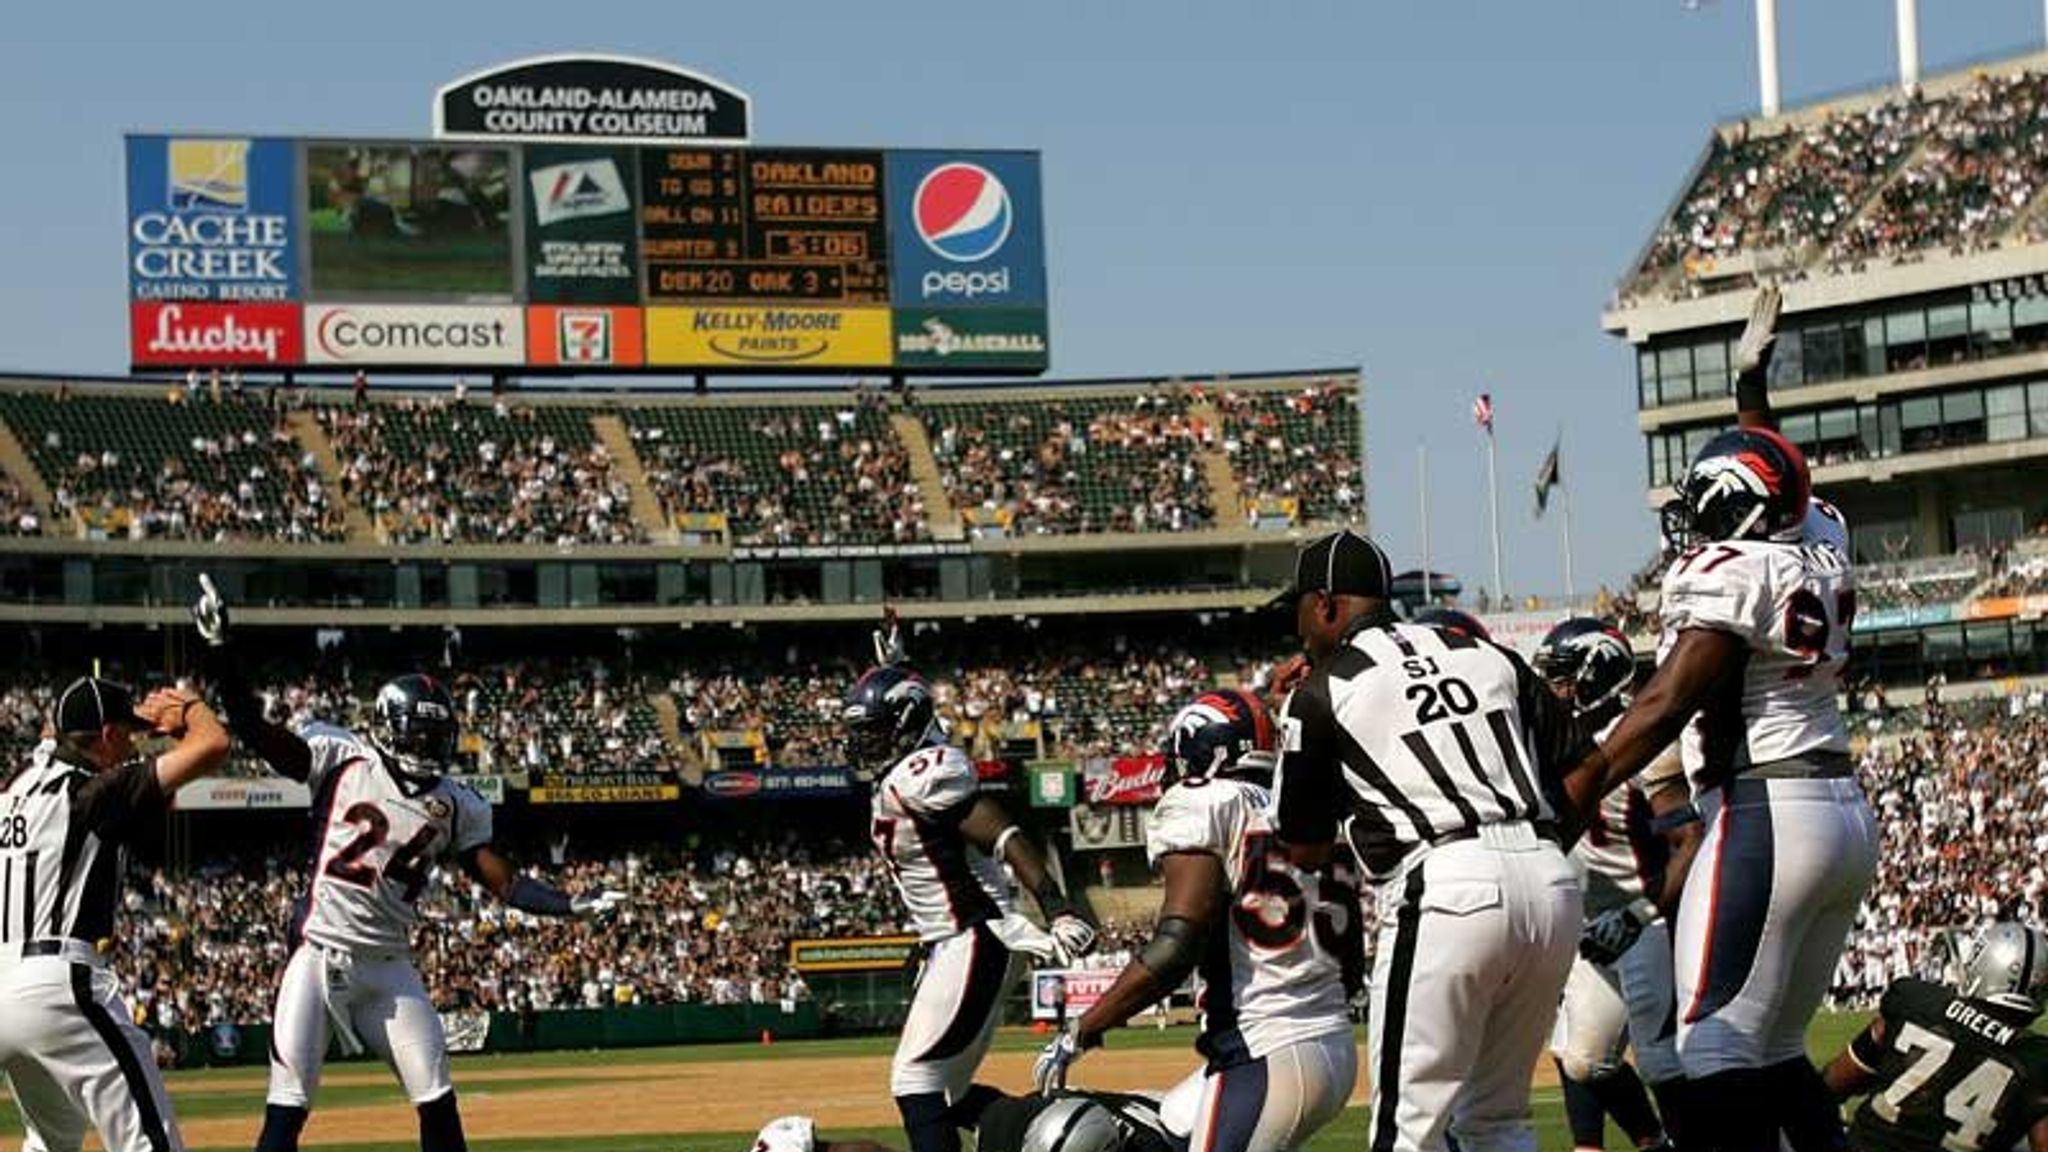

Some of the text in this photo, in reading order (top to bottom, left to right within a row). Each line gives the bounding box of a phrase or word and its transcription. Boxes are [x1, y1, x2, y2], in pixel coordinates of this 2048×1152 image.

[473, 85, 717, 112] OAKLAND-ALAMEDA
[485, 110, 707, 135] COUNTY COLISEUM
[752, 162, 876, 183] OAKLAND
[721, 207, 741, 225] 11
[754, 194, 878, 216] RAIDERS
[133, 212, 288, 246] CACHE
[788, 234, 862, 256] 5:06
[134, 247, 288, 279] CREEK
[135, 283, 288, 299] CASINO RESORT
[660, 268, 819, 293] DEN 20 OAK 3
[921, 266, 1009, 299] pepsi
[148, 304, 278, 361] Lucky
[692, 311, 842, 332] KELLY-MOORE
[738, 337, 798, 350] PAINTS
[1401, 655, 1441, 679] SJ
[1405, 677, 1479, 726] 20
[0, 815, 28, 849] 28
[324, 801, 439, 903] 24
[1944, 999, 2016, 1047] GREEN
[1870, 1020, 2016, 1150] 74
